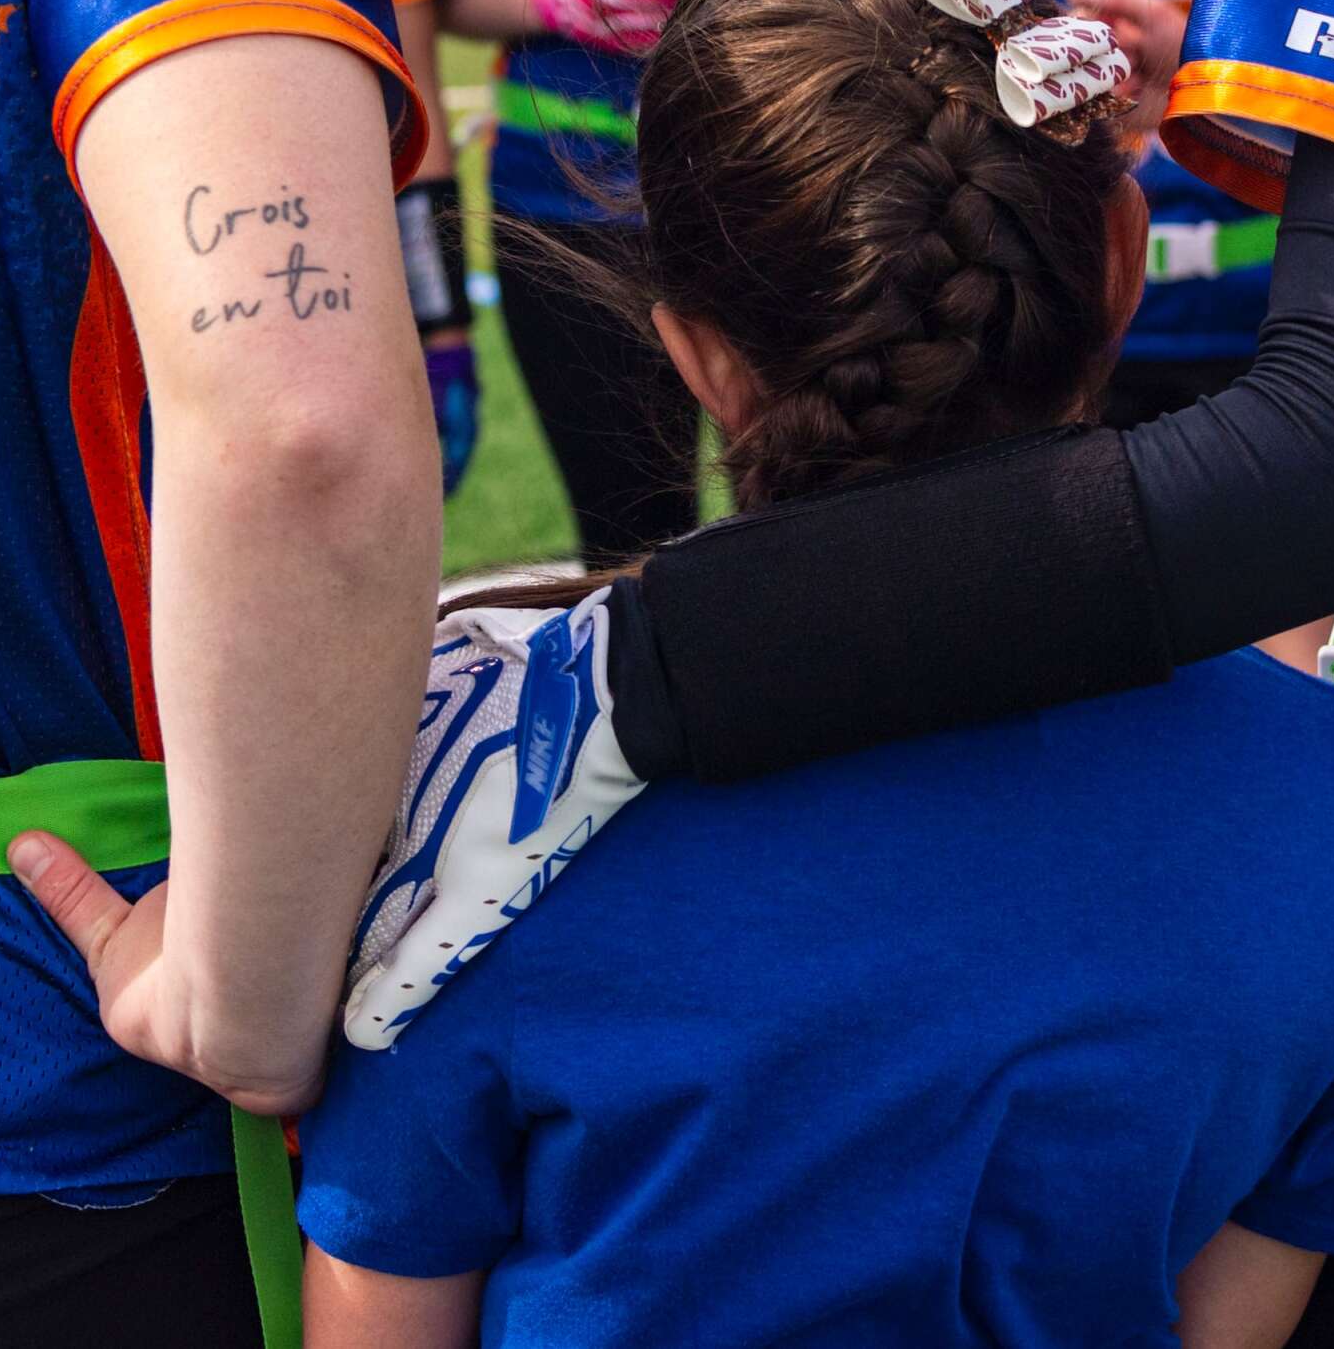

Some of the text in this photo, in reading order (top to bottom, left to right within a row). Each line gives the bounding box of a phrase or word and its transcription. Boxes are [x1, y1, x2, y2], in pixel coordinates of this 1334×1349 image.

[184, 185, 310, 256] Crois
[190, 299, 263, 334] en
[264, 241, 352, 321] toi
[525, 712, 556, 797] NIKE
